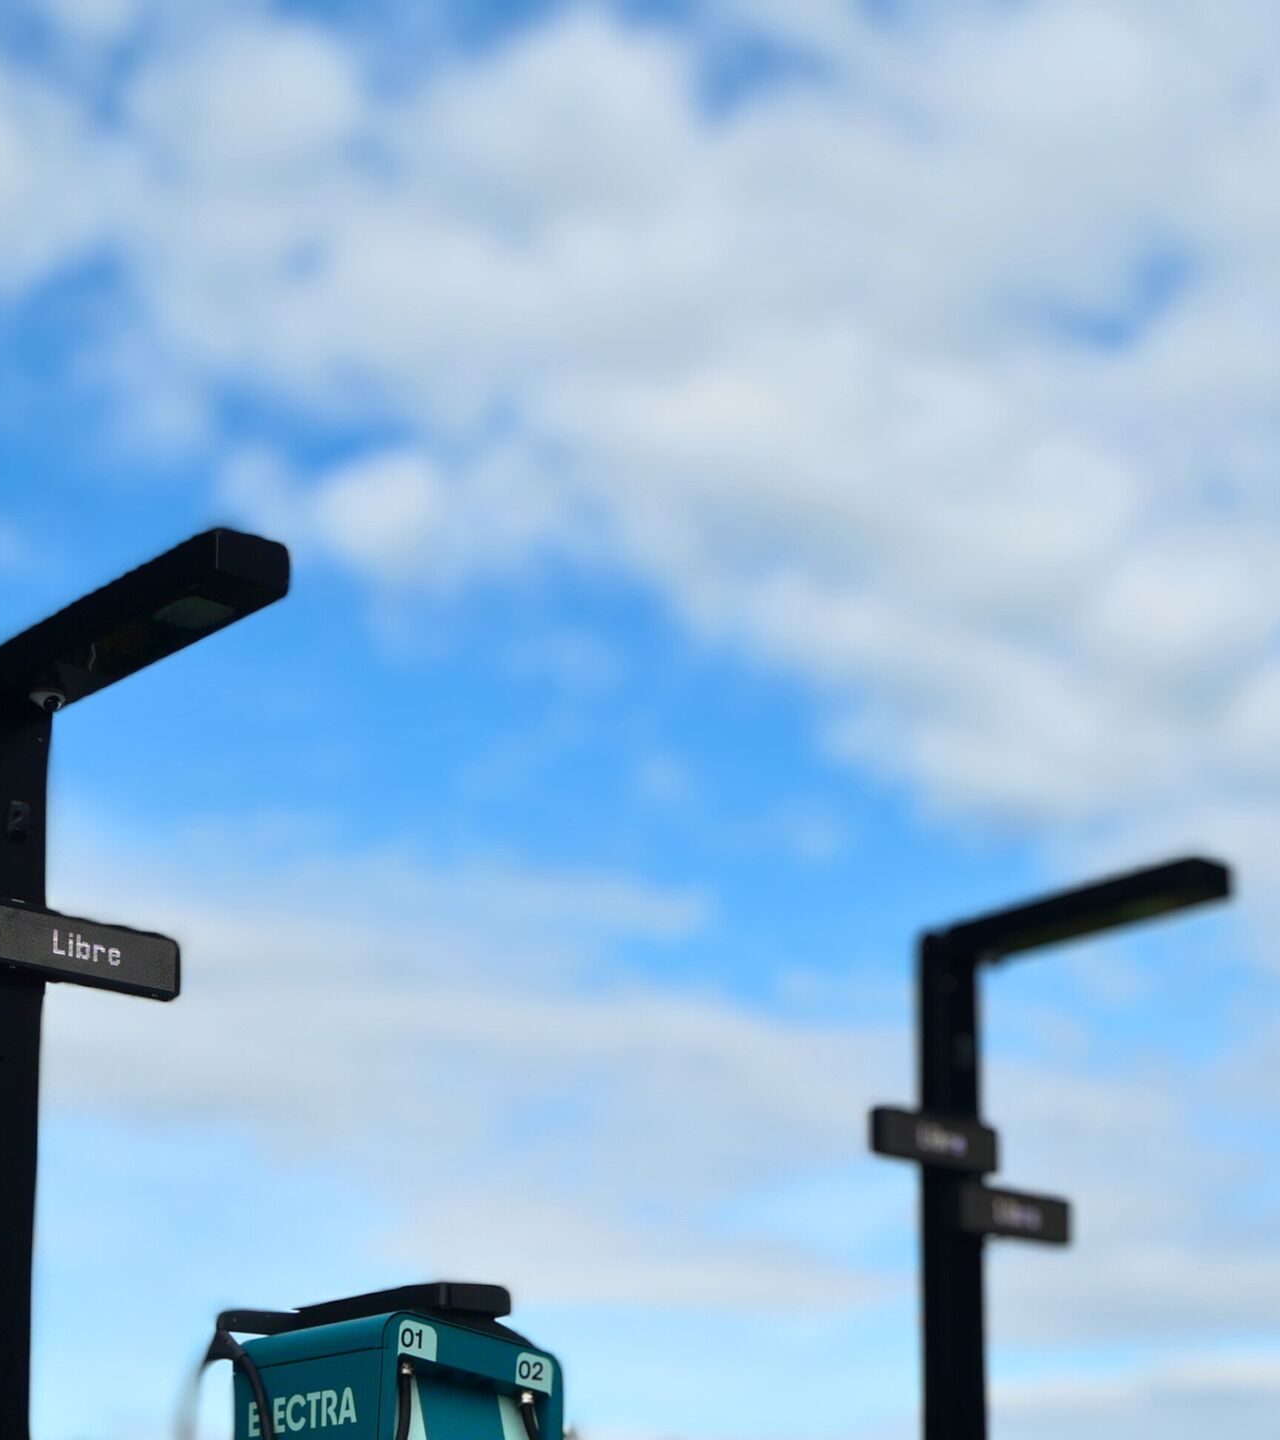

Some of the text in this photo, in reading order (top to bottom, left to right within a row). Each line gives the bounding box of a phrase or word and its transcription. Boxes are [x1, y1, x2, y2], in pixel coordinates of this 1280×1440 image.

[52, 928, 121, 967] Libre
[401, 1327, 424, 1350] 01
[518, 1360, 544, 1381] 02
[248, 1386, 358, 1438] EECTRA
